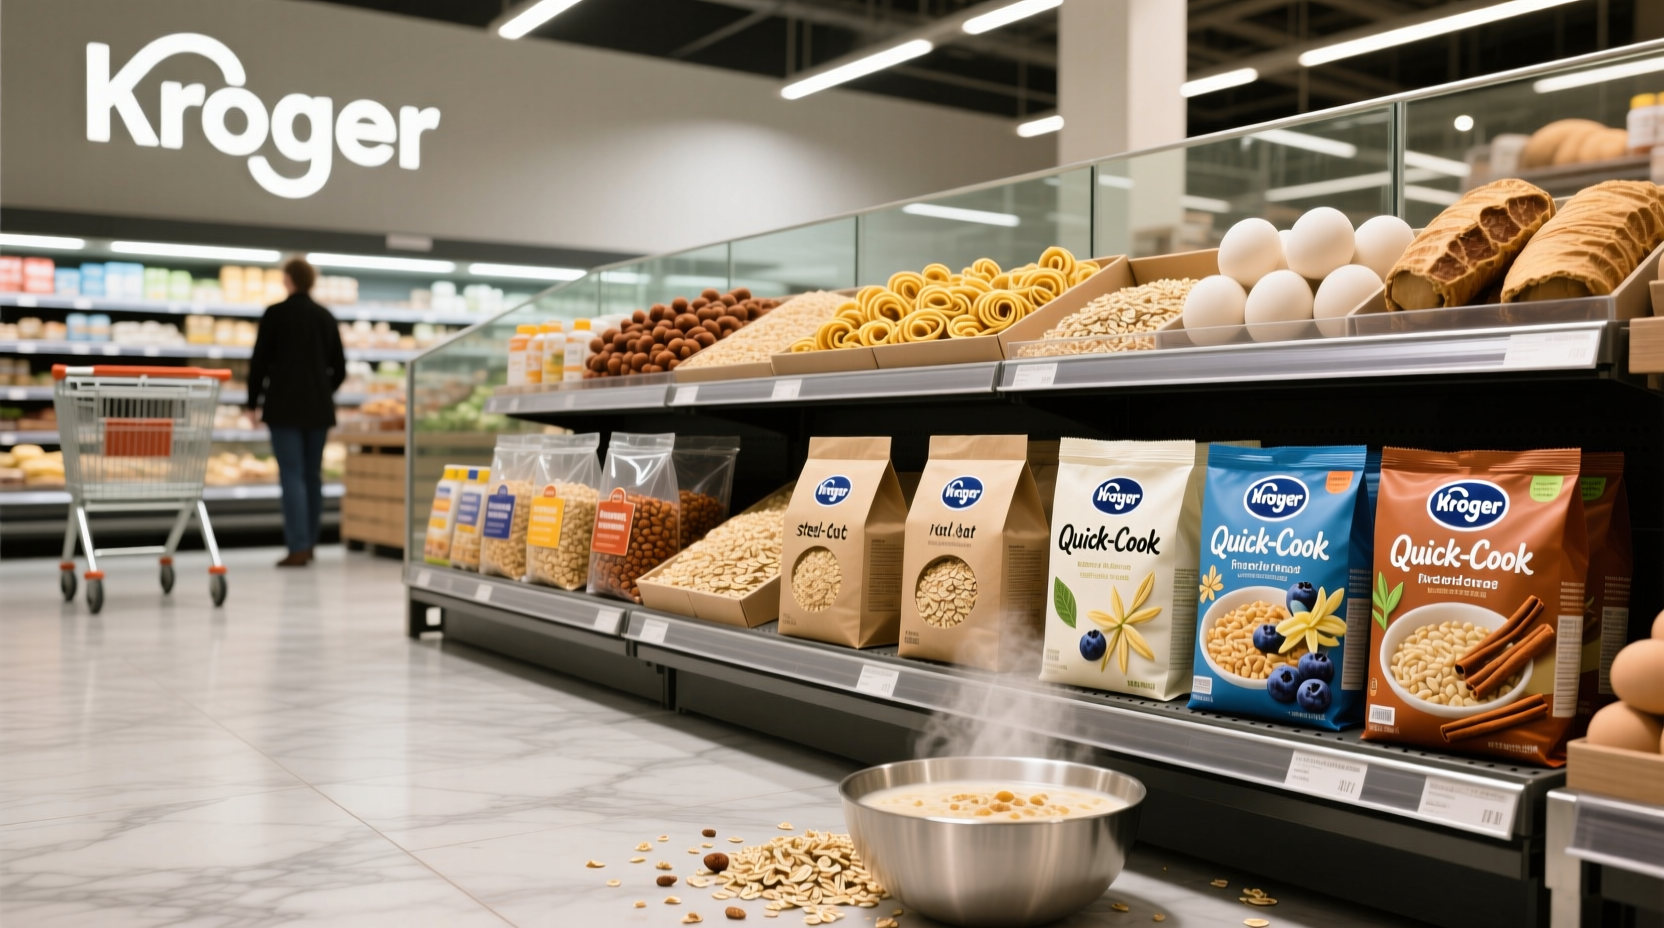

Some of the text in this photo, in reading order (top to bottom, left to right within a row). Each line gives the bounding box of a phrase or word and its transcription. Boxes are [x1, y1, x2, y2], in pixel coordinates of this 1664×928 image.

[86, 32, 441, 199] Kroger
[1436, 486, 1503, 523] Kroger
[1058, 523, 1161, 556] Quick-Cook
[1210, 525, 1330, 560] Quick-Cook
[1389, 533, 1534, 576] Quick-Cook
